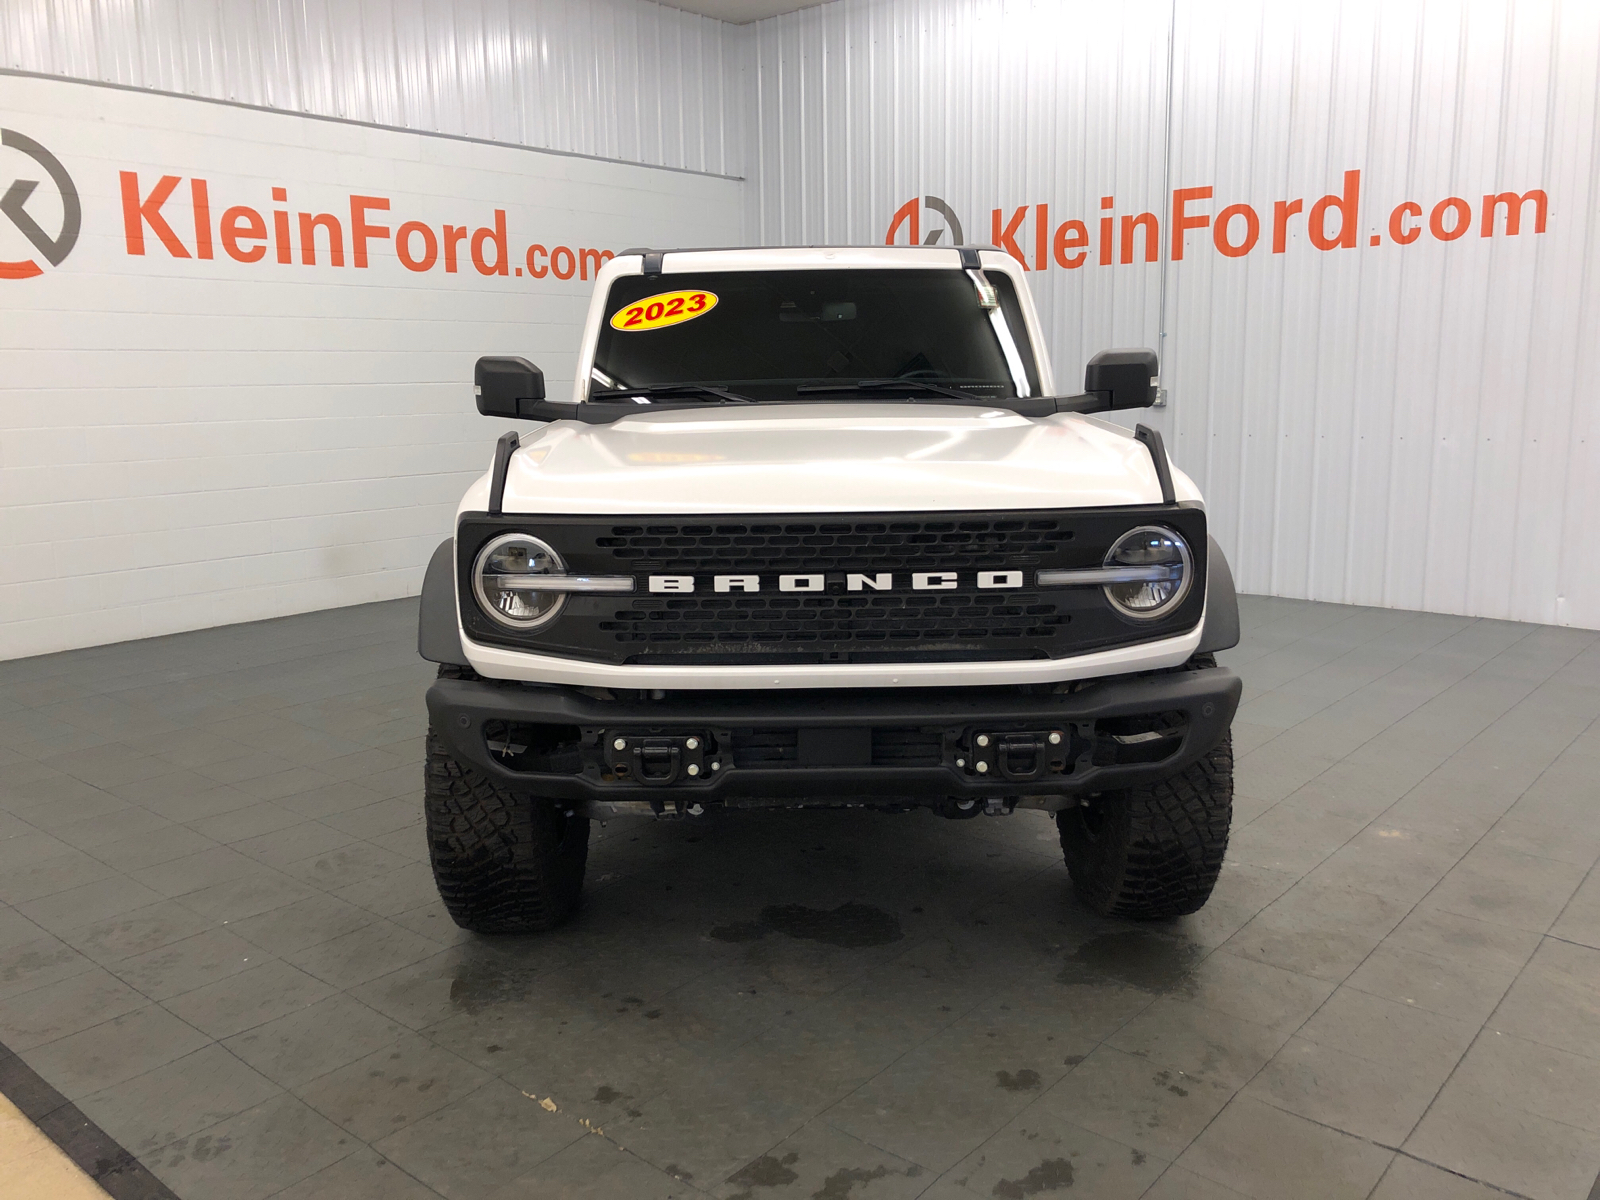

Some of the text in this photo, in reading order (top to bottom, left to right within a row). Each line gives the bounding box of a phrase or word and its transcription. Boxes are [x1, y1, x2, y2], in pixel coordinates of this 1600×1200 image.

[119, 171, 615, 281] KleinFord.com
[992, 170, 1548, 272] KleinFord.com
[623, 294, 707, 328] 2023
[648, 572, 1023, 593] BRONCO
